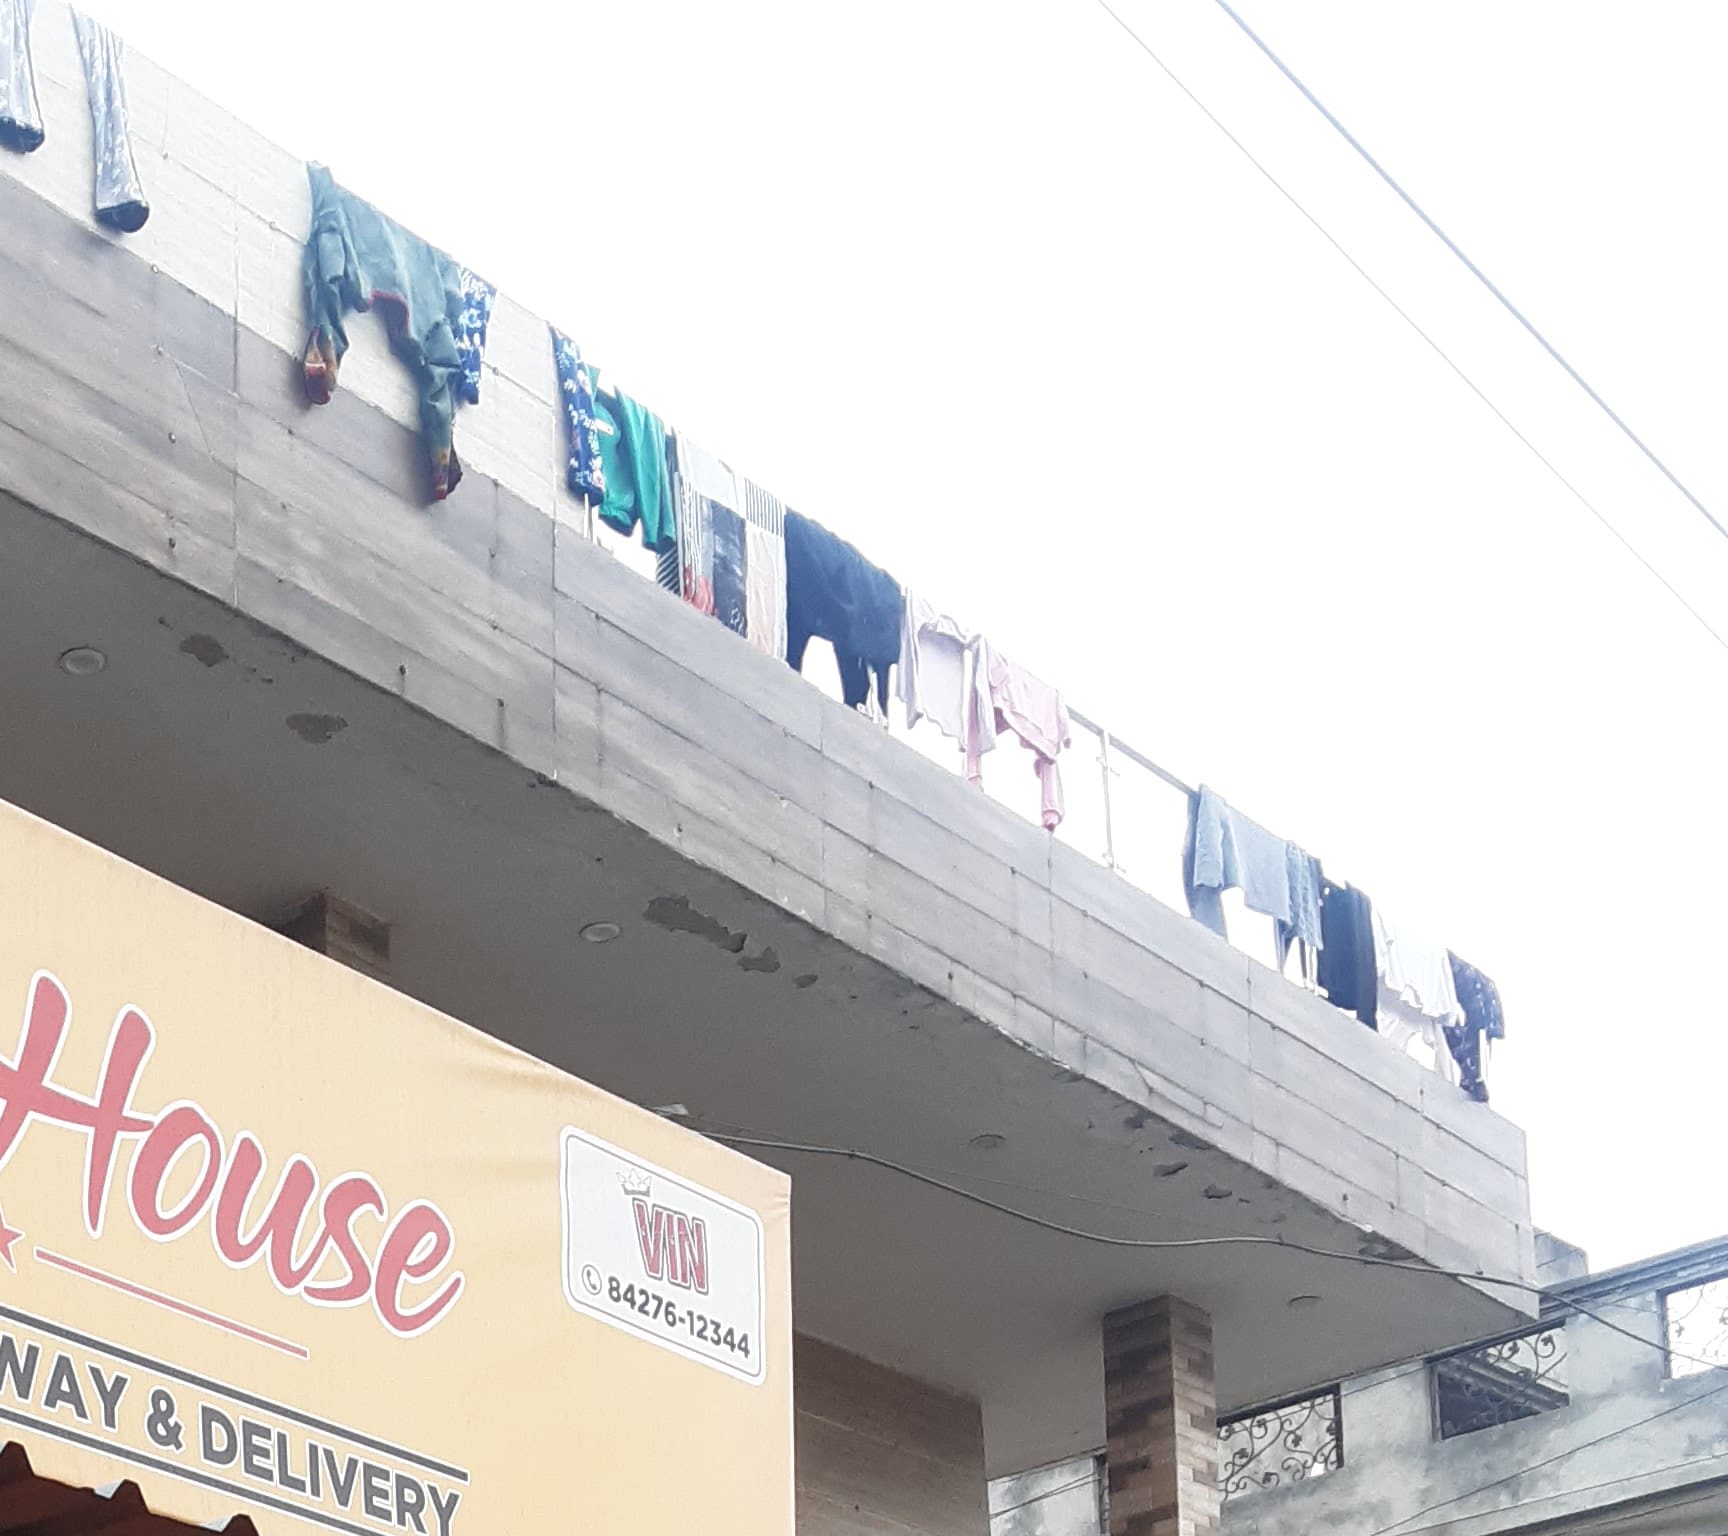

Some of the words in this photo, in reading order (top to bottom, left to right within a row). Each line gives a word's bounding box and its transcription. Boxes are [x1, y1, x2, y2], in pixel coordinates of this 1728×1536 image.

[632, 1197, 709, 1296] VIN
[608, 1276, 750, 1358] 84276-12344
[147, 1389, 184, 1451] &
